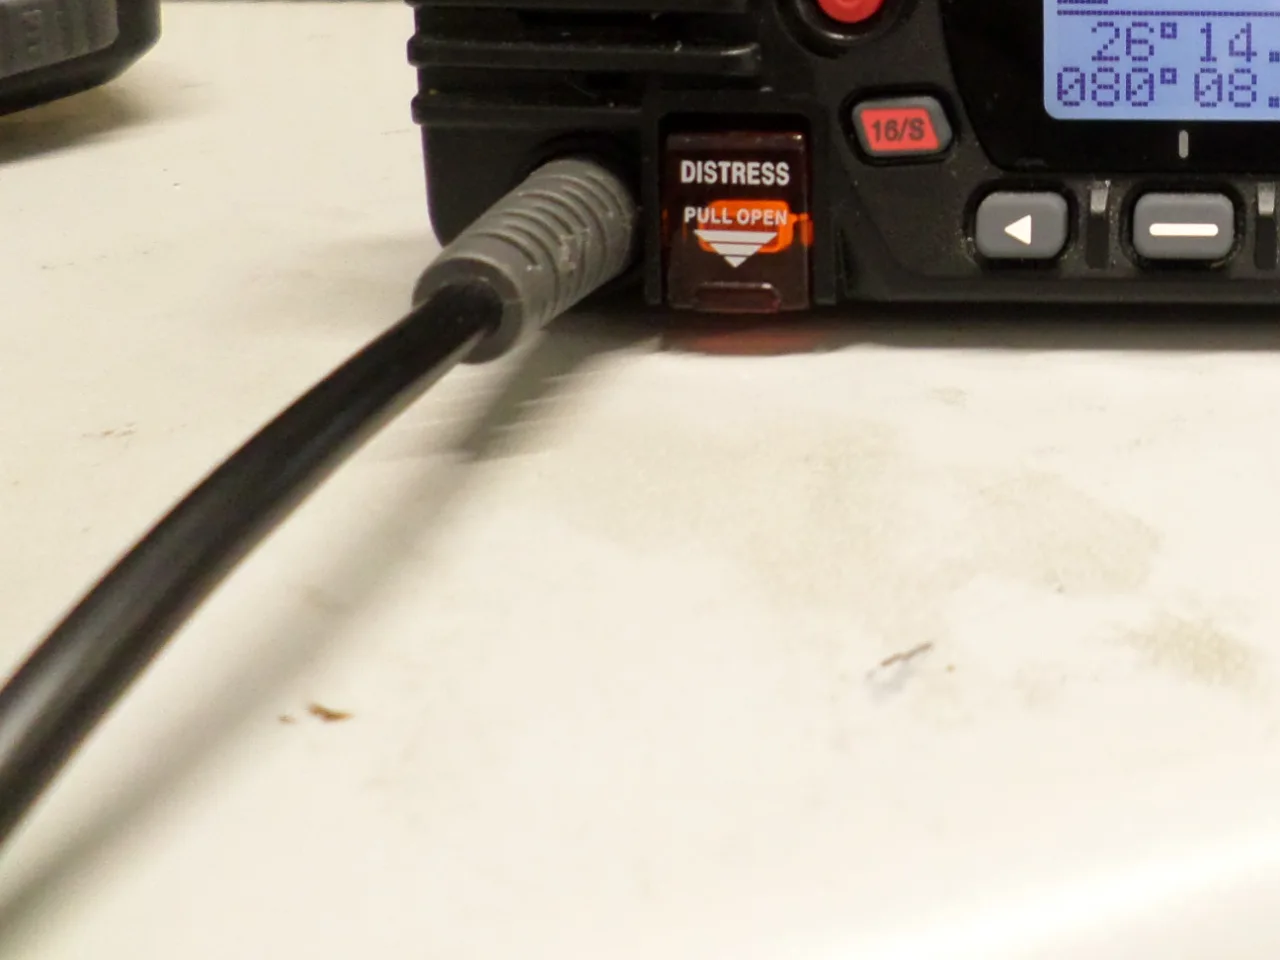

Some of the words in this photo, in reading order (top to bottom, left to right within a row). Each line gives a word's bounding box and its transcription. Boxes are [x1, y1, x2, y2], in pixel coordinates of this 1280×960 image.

[870, 117, 926, 143] 16/S
[680, 159, 790, 187] DISTRESS
[683, 205, 733, 225] PULL
[736, 207, 788, 226] OPEN
